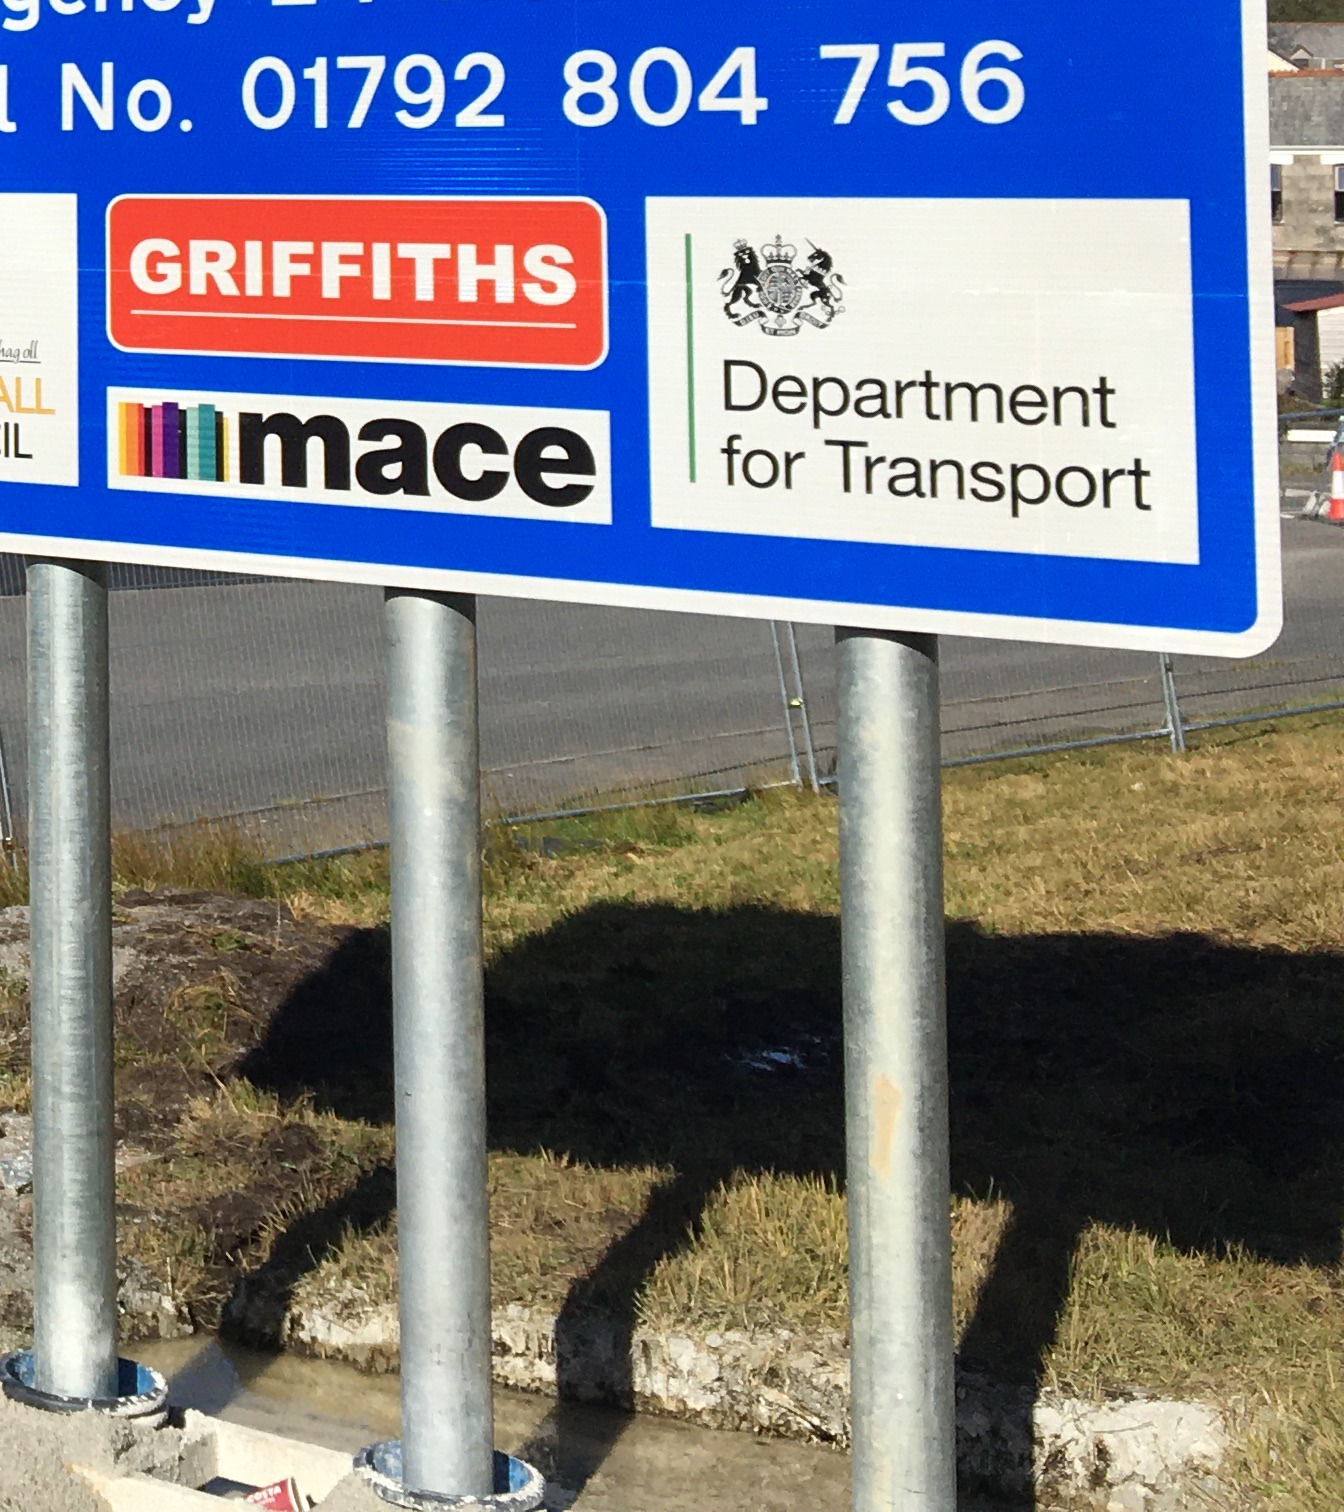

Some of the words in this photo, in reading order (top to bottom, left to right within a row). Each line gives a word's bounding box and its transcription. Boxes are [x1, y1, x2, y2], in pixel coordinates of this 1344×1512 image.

[62, 62, 192, 131] No.
[243, 52, 505, 129] 01792
[563, 47, 768, 127] 804
[820, 40, 1024, 125] 756
[130, 239, 576, 305] GRIFFITHS
[724, 360, 1116, 429] Department
[239, 412, 596, 507] mace
[721, 435, 805, 489] for
[825, 440, 1151, 517] Transport
